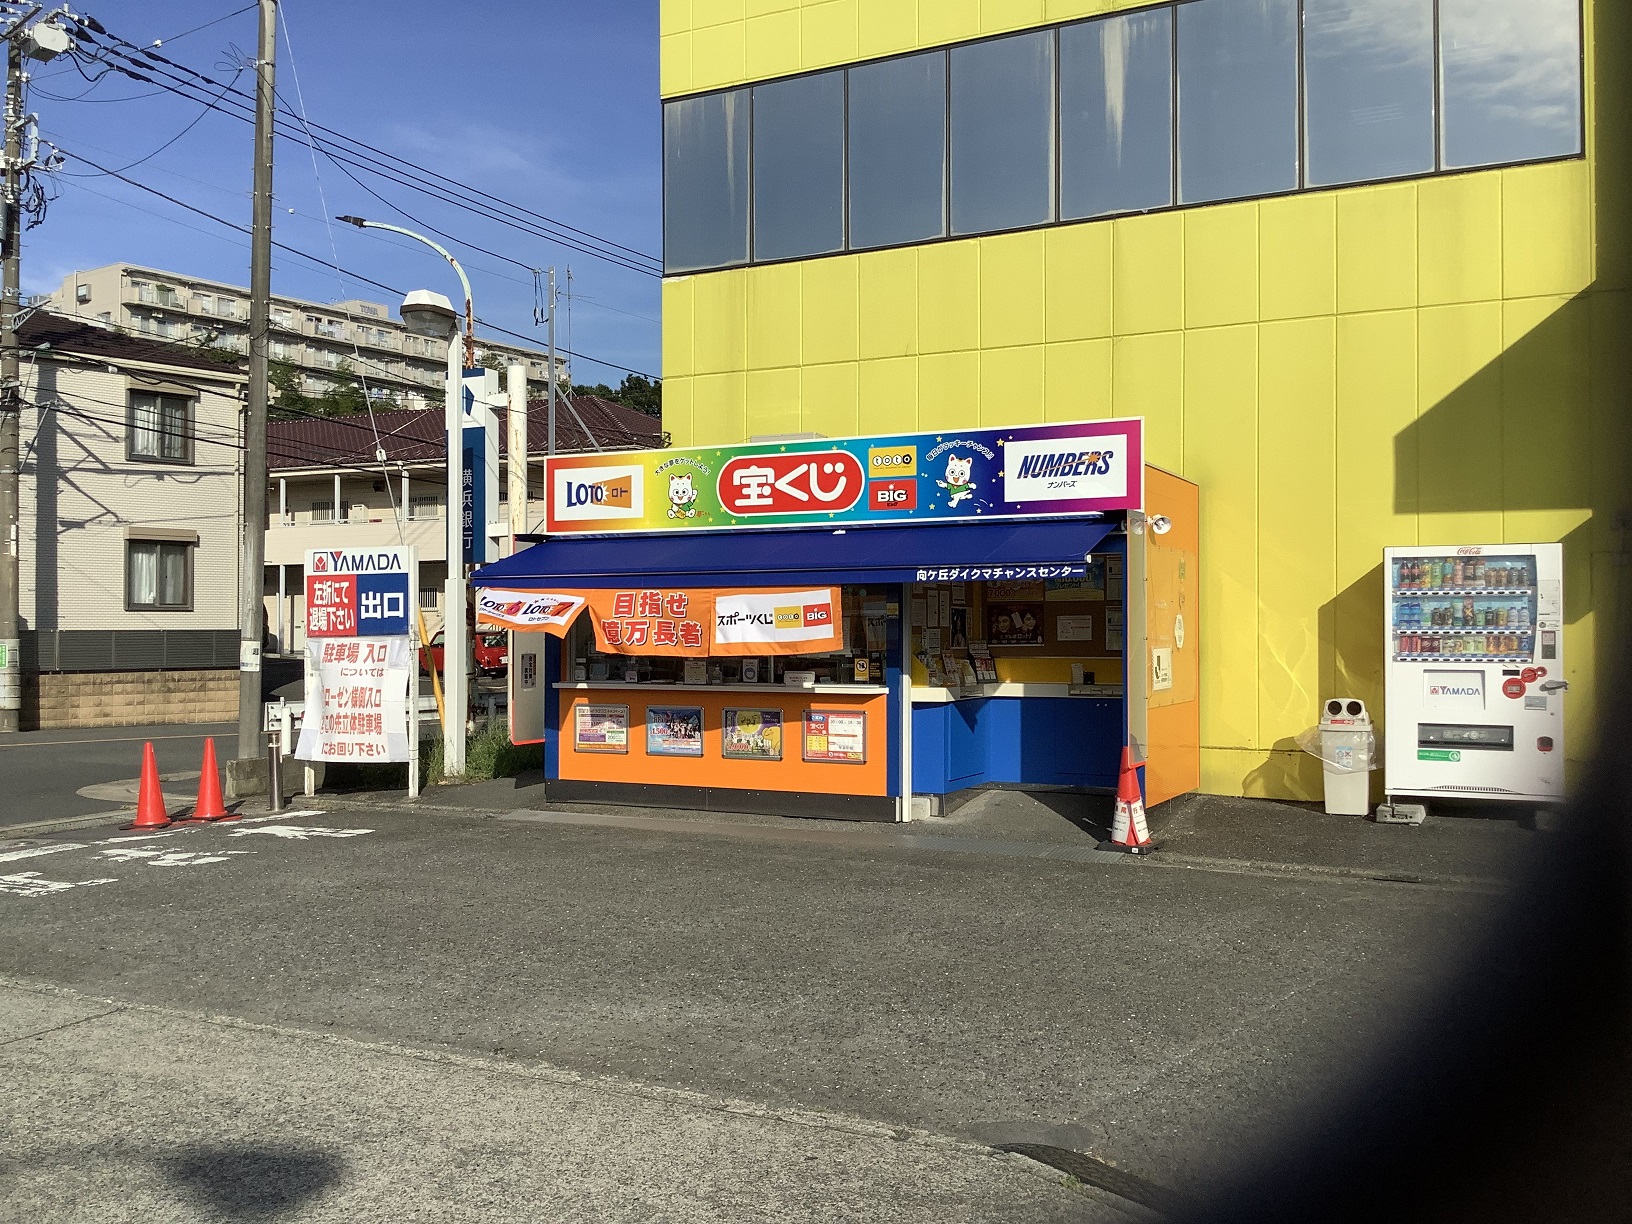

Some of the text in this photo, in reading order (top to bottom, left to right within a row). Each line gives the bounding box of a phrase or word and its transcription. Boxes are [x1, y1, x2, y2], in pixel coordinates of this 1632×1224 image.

[872, 453, 912, 467] toto
[1017, 450, 1114, 480] NUMBERS
[611, 487, 628, 498] ロト
[733, 461, 847, 507] 宝くじ
[877, 484, 908, 503] BIG
[1047, 480, 1077, 489] ナンバーズ
[566, 481, 604, 508] LOTO
[329, 551, 402, 572] YAMADA
[313, 581, 350, 605] 左折にて
[360, 591, 405, 619] 出口
[521, 604, 551, 616] LOTO
[613, 590, 689, 618] 目指せ
[309, 607, 354, 632] 退場下さい
[717, 612, 771, 627] スポーツくじ
[777, 613, 800, 622] toto
[806, 607, 828, 621] BIG
[601, 619, 703, 647] 億万長者
[322, 643, 387, 664] 駐車場 入口
[341, 667, 385, 678] については
[1440, 686, 1480, 696] YAMADA
[321, 742, 386, 756] にお回り下さい
